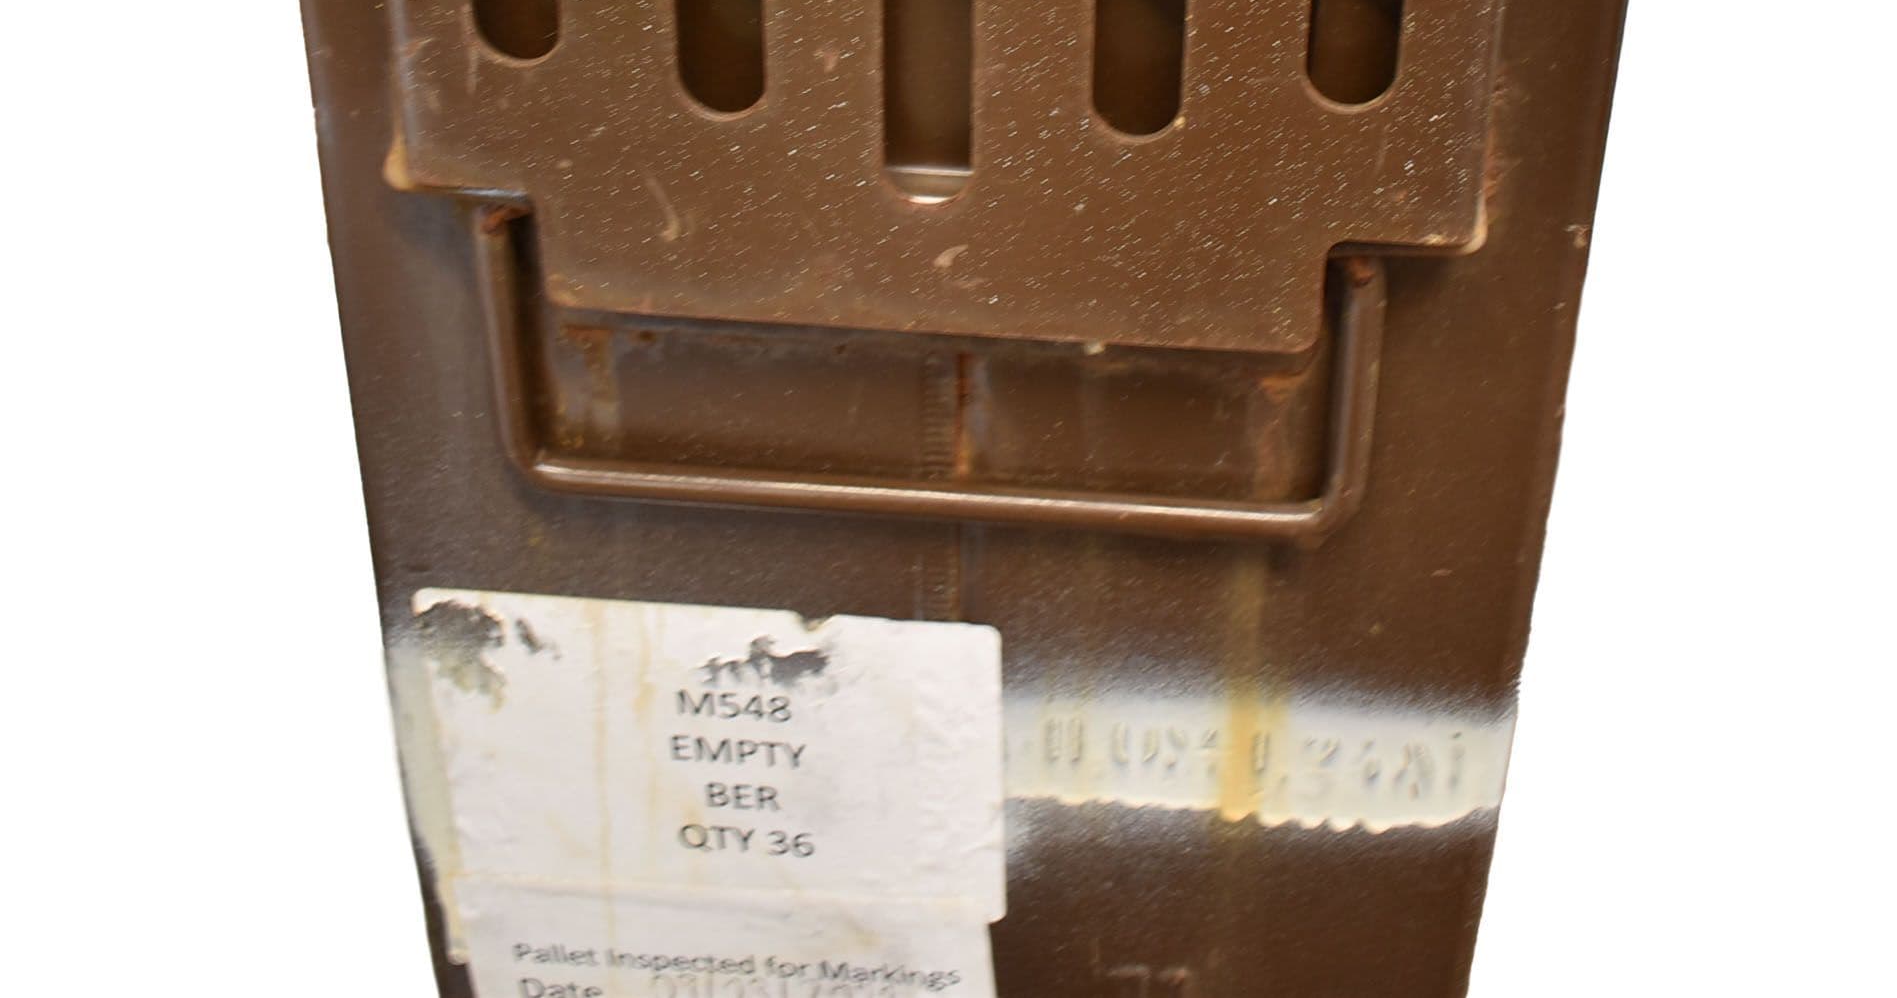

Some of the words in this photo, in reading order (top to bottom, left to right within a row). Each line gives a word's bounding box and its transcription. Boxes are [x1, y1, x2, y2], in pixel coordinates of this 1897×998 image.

[676, 688, 793, 723] M548
[670, 734, 806, 769] EMPTY
[706, 782, 781, 812] BER
[678, 823, 755, 853] QTY
[767, 830, 816, 859] 36
[512, 942, 597, 967] Pallet
[606, 948, 756, 975] Inspected
[765, 955, 809, 979] for
[817, 959, 961, 991] Markings
[517, 977, 603, 998] Date
